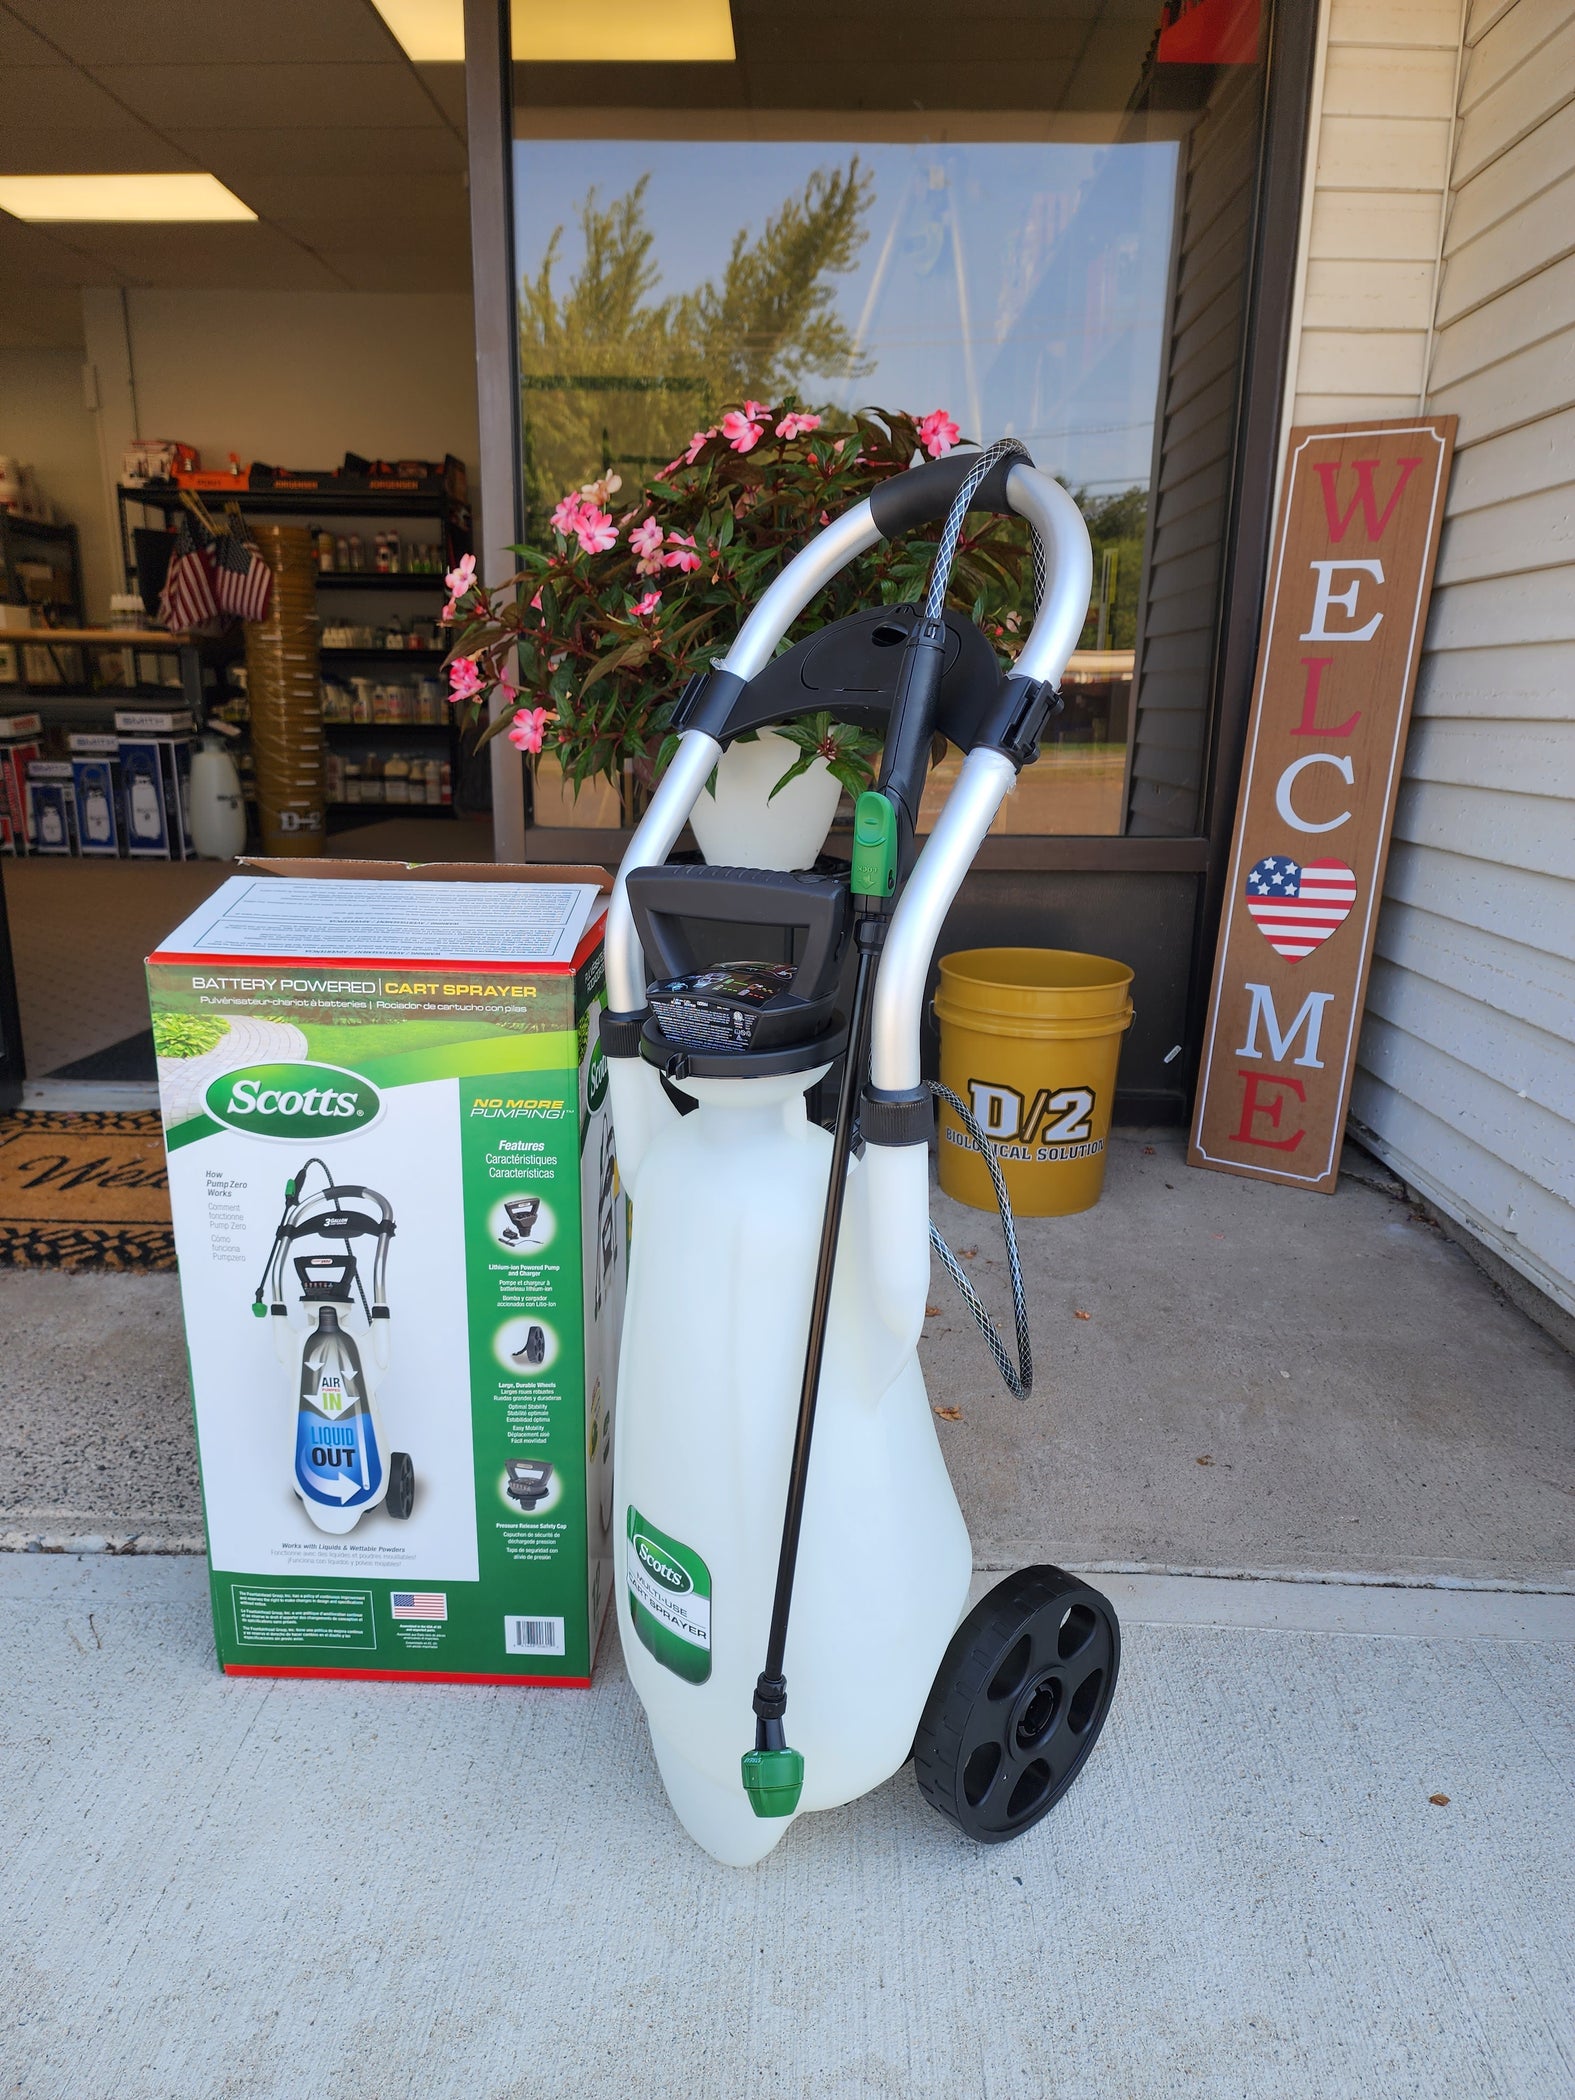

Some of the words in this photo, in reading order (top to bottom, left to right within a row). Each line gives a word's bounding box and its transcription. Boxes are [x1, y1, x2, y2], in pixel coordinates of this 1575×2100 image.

[1229, 458, 1423, 1152] WELCME
[192, 977, 277, 991] BATTERY
[280, 979, 376, 994] POWERED
[384, 983, 440, 995] CART
[443, 984, 537, 998] SPRAYER
[318, 999, 367, 1009] batteries
[376, 1000, 423, 1010] Rociador
[423, 1002, 437, 1011] de
[437, 1002, 484, 1012] cartucho
[485, 1005, 504, 1013] con
[504, 1004, 528, 1014] pilas
[227, 1080, 358, 1117] Scotts
[473, 1098, 503, 1108] NO
[505, 1099, 565, 1110] MORE
[968, 1079, 1096, 1144] D/2
[498, 1139, 545, 1152] Features
[946, 1127, 1031, 1160] BIOLOICAL
[1037, 1138, 1105, 1161] SOLUTION
[485, 1153, 558, 1167] Caractéristiques
[205, 1170, 224, 1179] How
[489, 1166, 555, 1179] Características
[206, 1179, 229, 1189] Pump
[230, 1180, 248, 1189] Zero
[207, 1189, 233, 1198] Works
[322, 1377, 341, 1388] AIR
[322, 1392, 342, 1411] IN
[311, 1426, 355, 1447] LIQUID
[311, 1447, 356, 1468] OUT
[639, 1543, 682, 1586] Scotts
[636, 1572, 688, 1618] MULTI-USE
[628, 1571, 649, 1601] CART
[649, 1599, 707, 1640] SPRAYER
